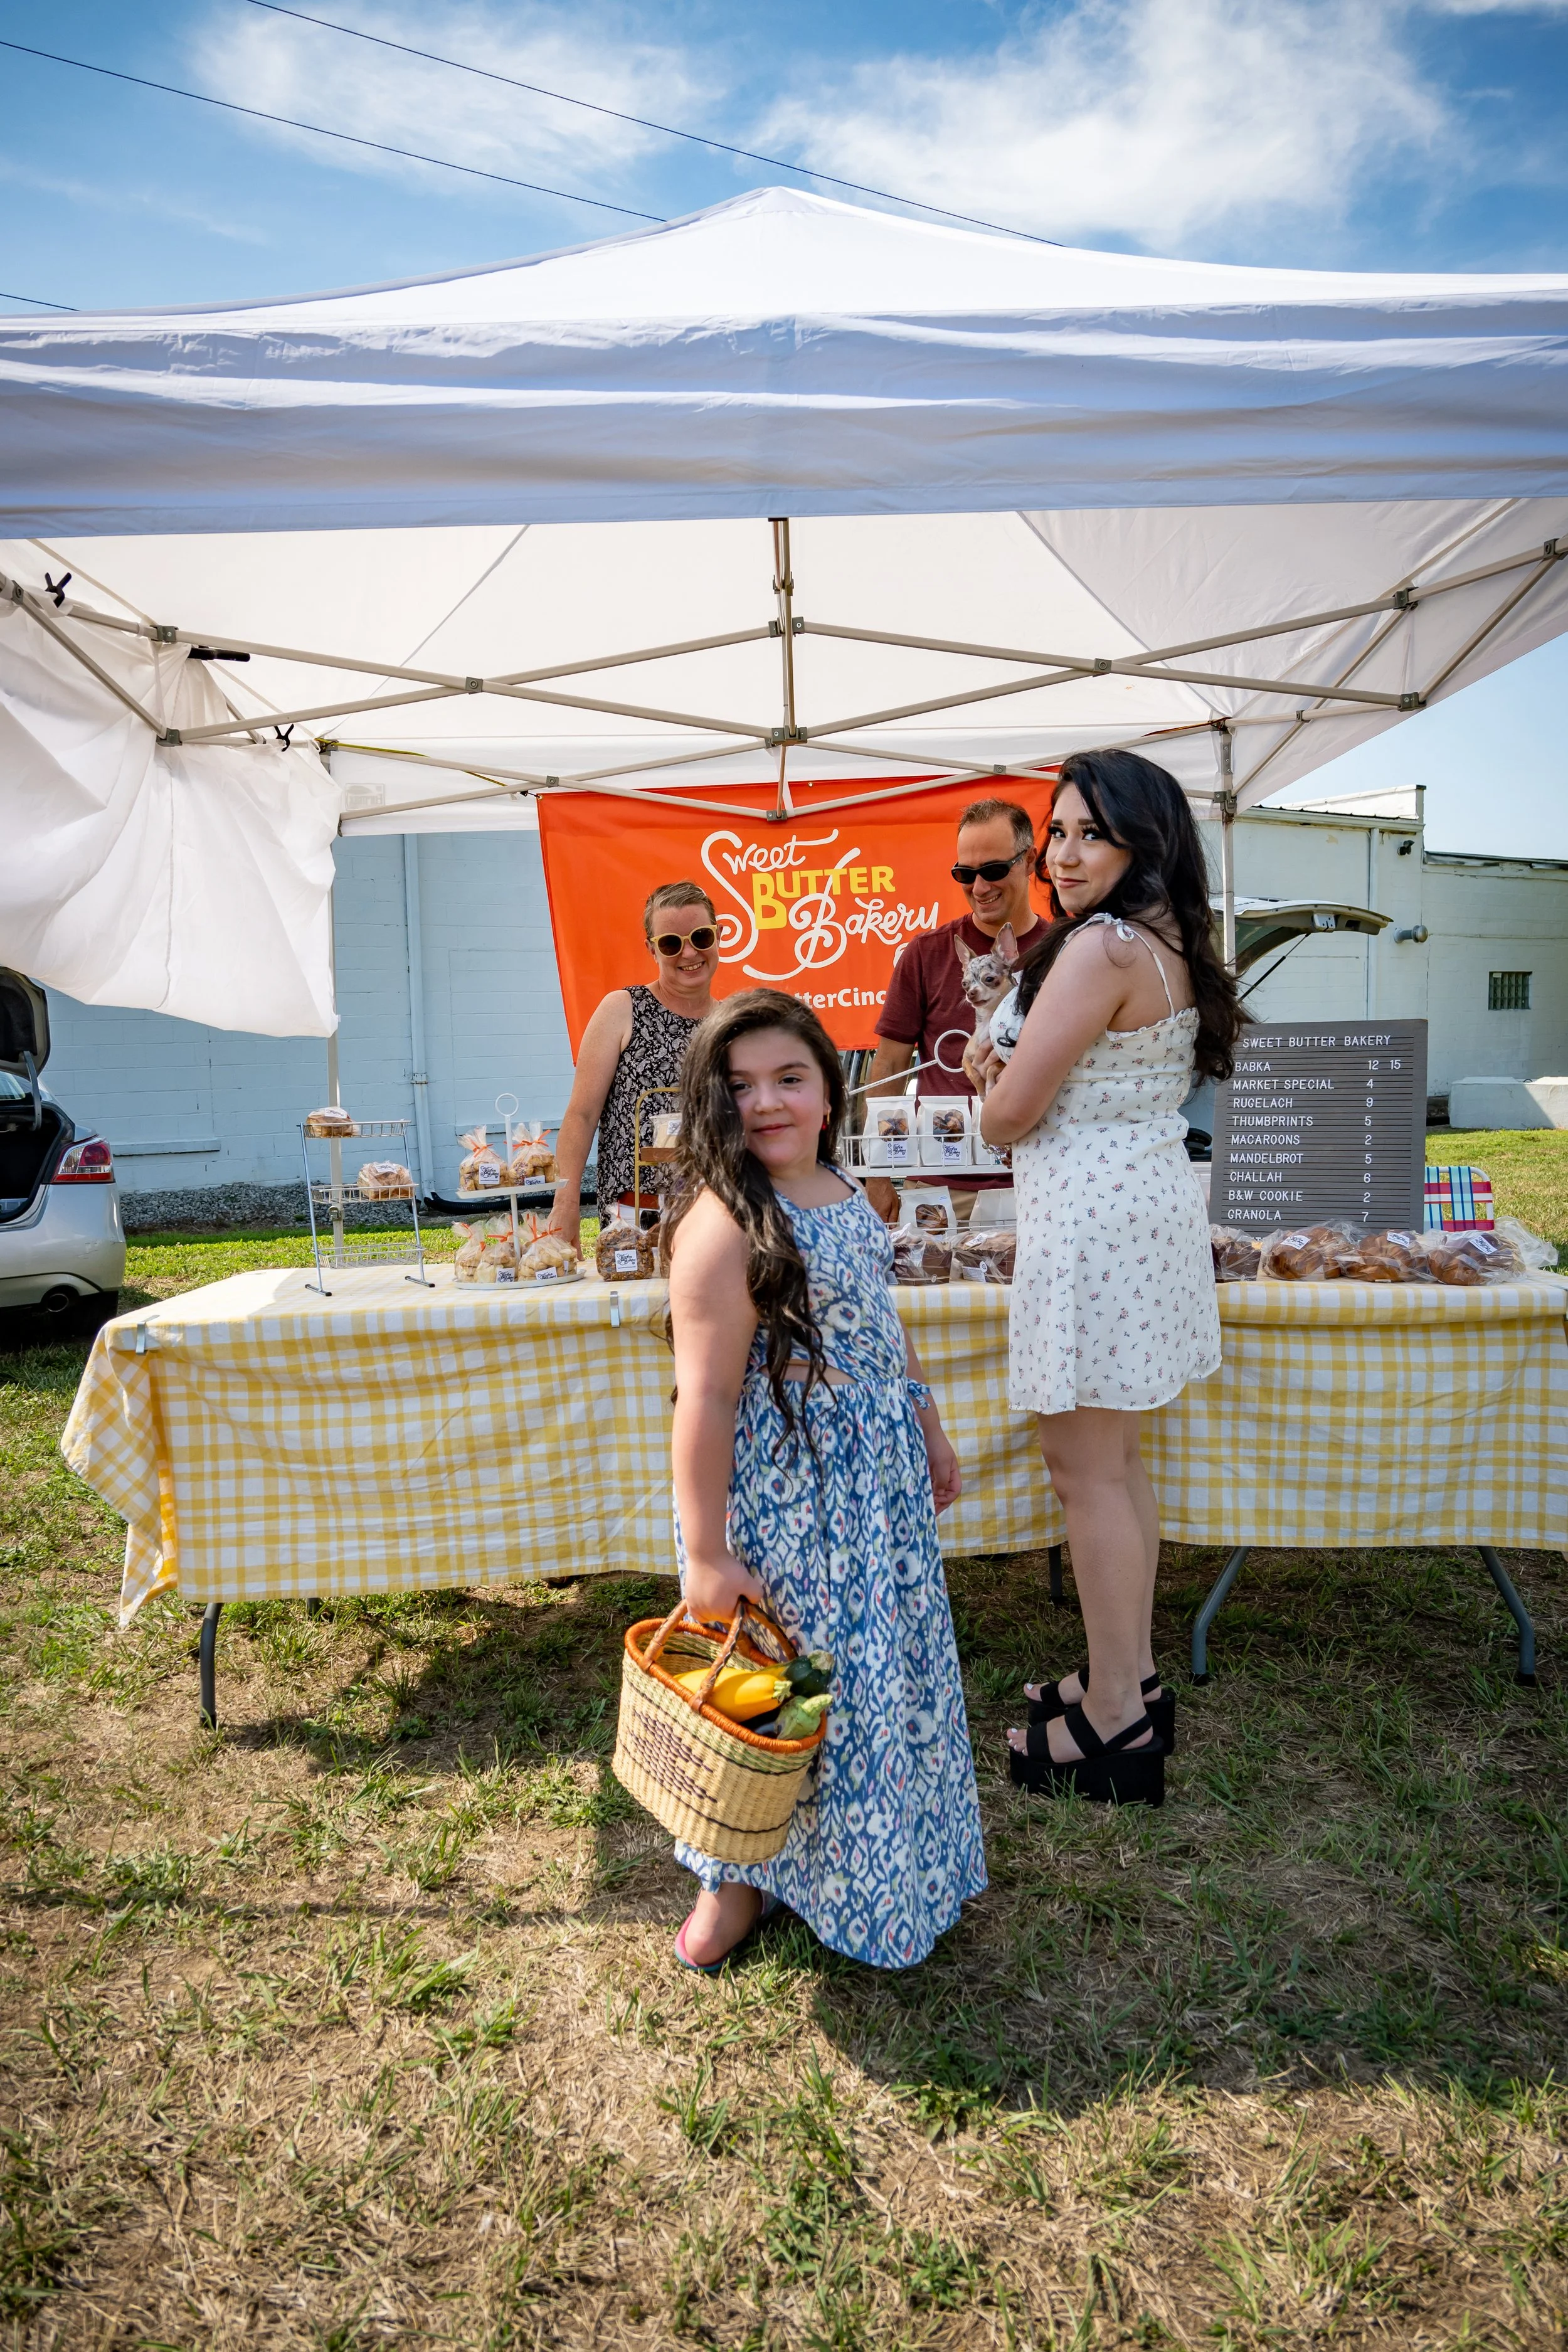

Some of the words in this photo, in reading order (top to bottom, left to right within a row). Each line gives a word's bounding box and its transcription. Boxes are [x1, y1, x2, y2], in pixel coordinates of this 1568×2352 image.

[701, 829, 839, 963] Sweet
[752, 866, 896, 930] BUTTER
[1242, 1037, 1282, 1049] SWEET
[1289, 1036, 1335, 1047] BUTTER
[1344, 1035, 1391, 1046] BAKERY
[1235, 1061, 1271, 1072] BABKA
[1368, 1059, 1379, 1070] 12
[1390, 1059, 1401, 1070] 15
[1232, 1079, 1278, 1091] MARKET
[1284, 1079, 1334, 1090] SPECIAL
[1366, 1078, 1374, 1089] 4
[1233, 1098, 1293, 1108] RUGELACH
[1366, 1097, 1373, 1108] 9
[1232, 1115, 1313, 1126] THUMBPRINTS
[1364, 1116, 1372, 1126] 5
[1231, 1134, 1300, 1146] MACAROONS
[1365, 1135, 1372, 1145] 2
[1230, 1152, 1303, 1164] MANDELBROT
[1365, 1153, 1372, 1164] 5
[1229, 1171, 1282, 1183] CHALLAH
[1364, 1172, 1371, 1183] 6
[1228, 1190, 1253, 1200] B&W
[1259, 1190, 1303, 1202] COOKIE
[1363, 1192, 1370, 1203] 2
[1227, 1209, 1281, 1221] GRANOLA
[1362, 1211, 1369, 1222] 7
